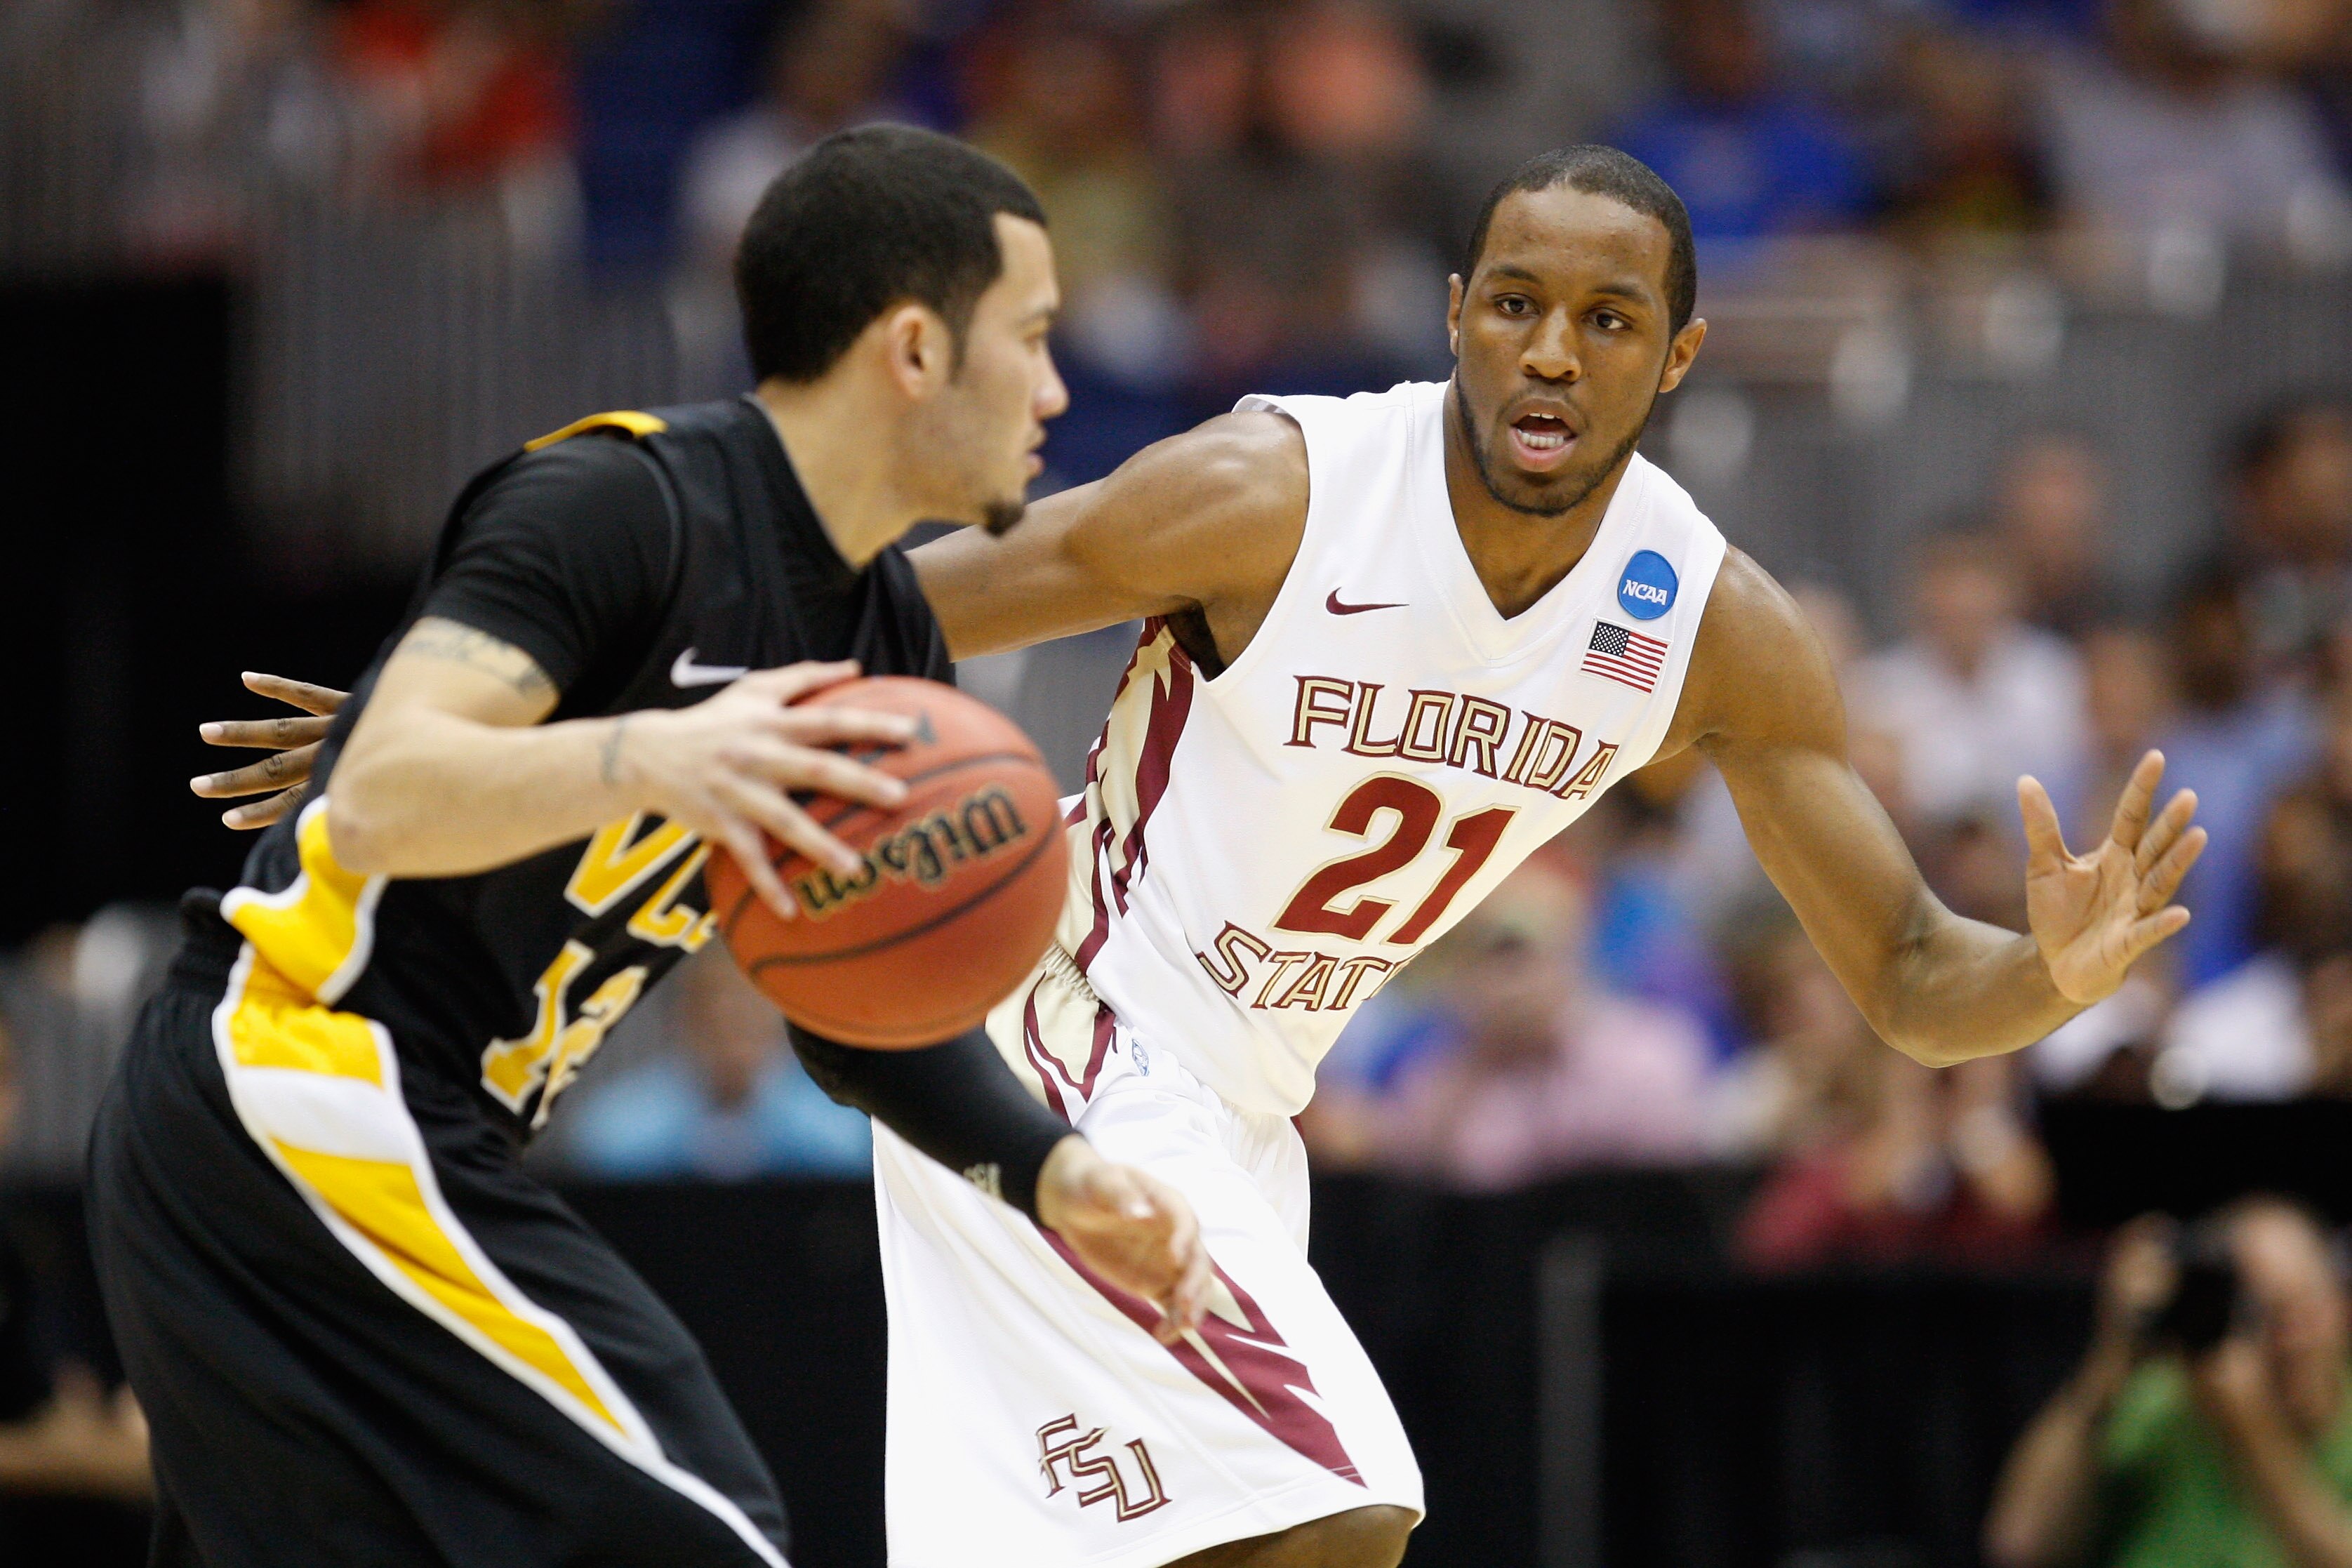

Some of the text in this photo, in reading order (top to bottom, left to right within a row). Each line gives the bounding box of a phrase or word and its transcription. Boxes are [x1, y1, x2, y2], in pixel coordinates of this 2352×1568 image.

[1622, 579, 1668, 606] NCAA
[1282, 675, 1619, 800] FLORIDA
[564, 811, 718, 953] VC
[798, 784, 1028, 918] Wilson
[1267, 771, 1522, 947] 21
[1195, 920, 1423, 1012] STAT
[480, 938, 649, 1130] 12
[1035, 1413, 1173, 1523] FSU
